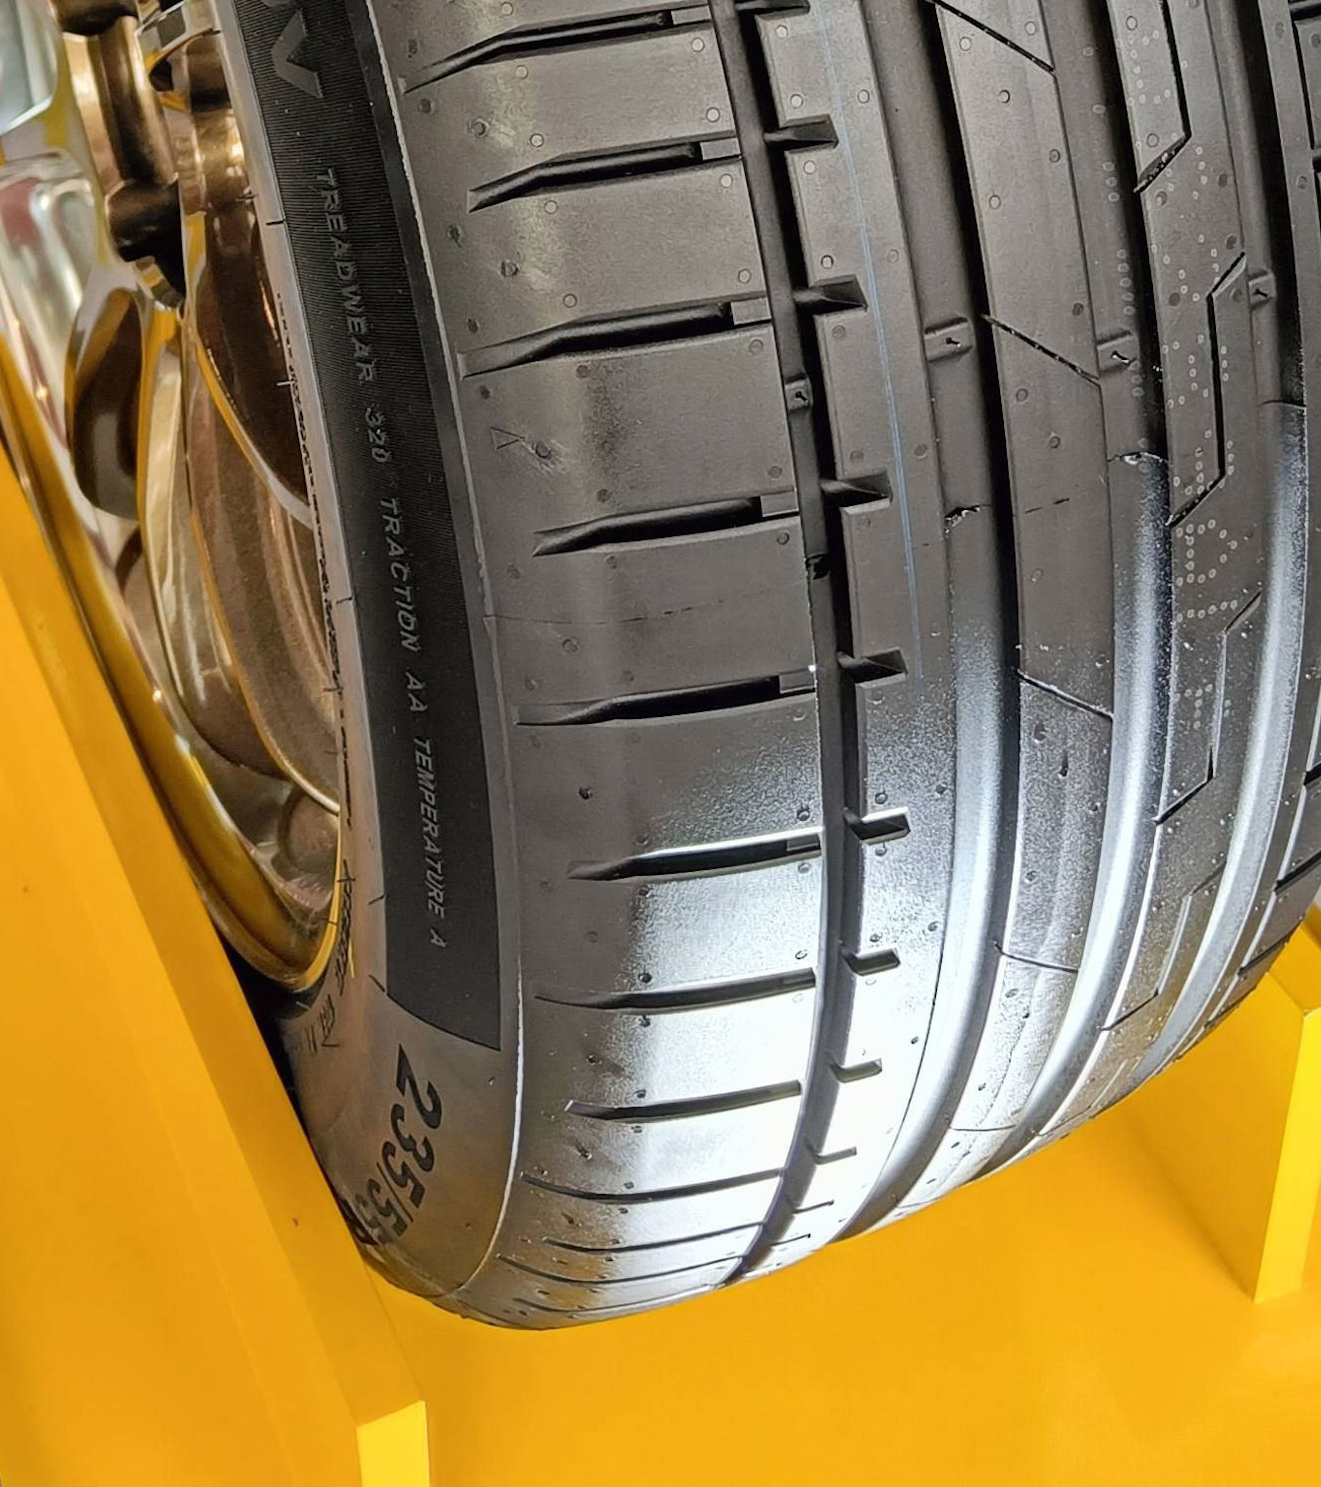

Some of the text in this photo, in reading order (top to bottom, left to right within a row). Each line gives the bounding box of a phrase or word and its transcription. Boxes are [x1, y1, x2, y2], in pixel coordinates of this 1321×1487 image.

[316, 167, 447, 949] TREADWEAR 320 TRACTION AA TEMPERATURE A
